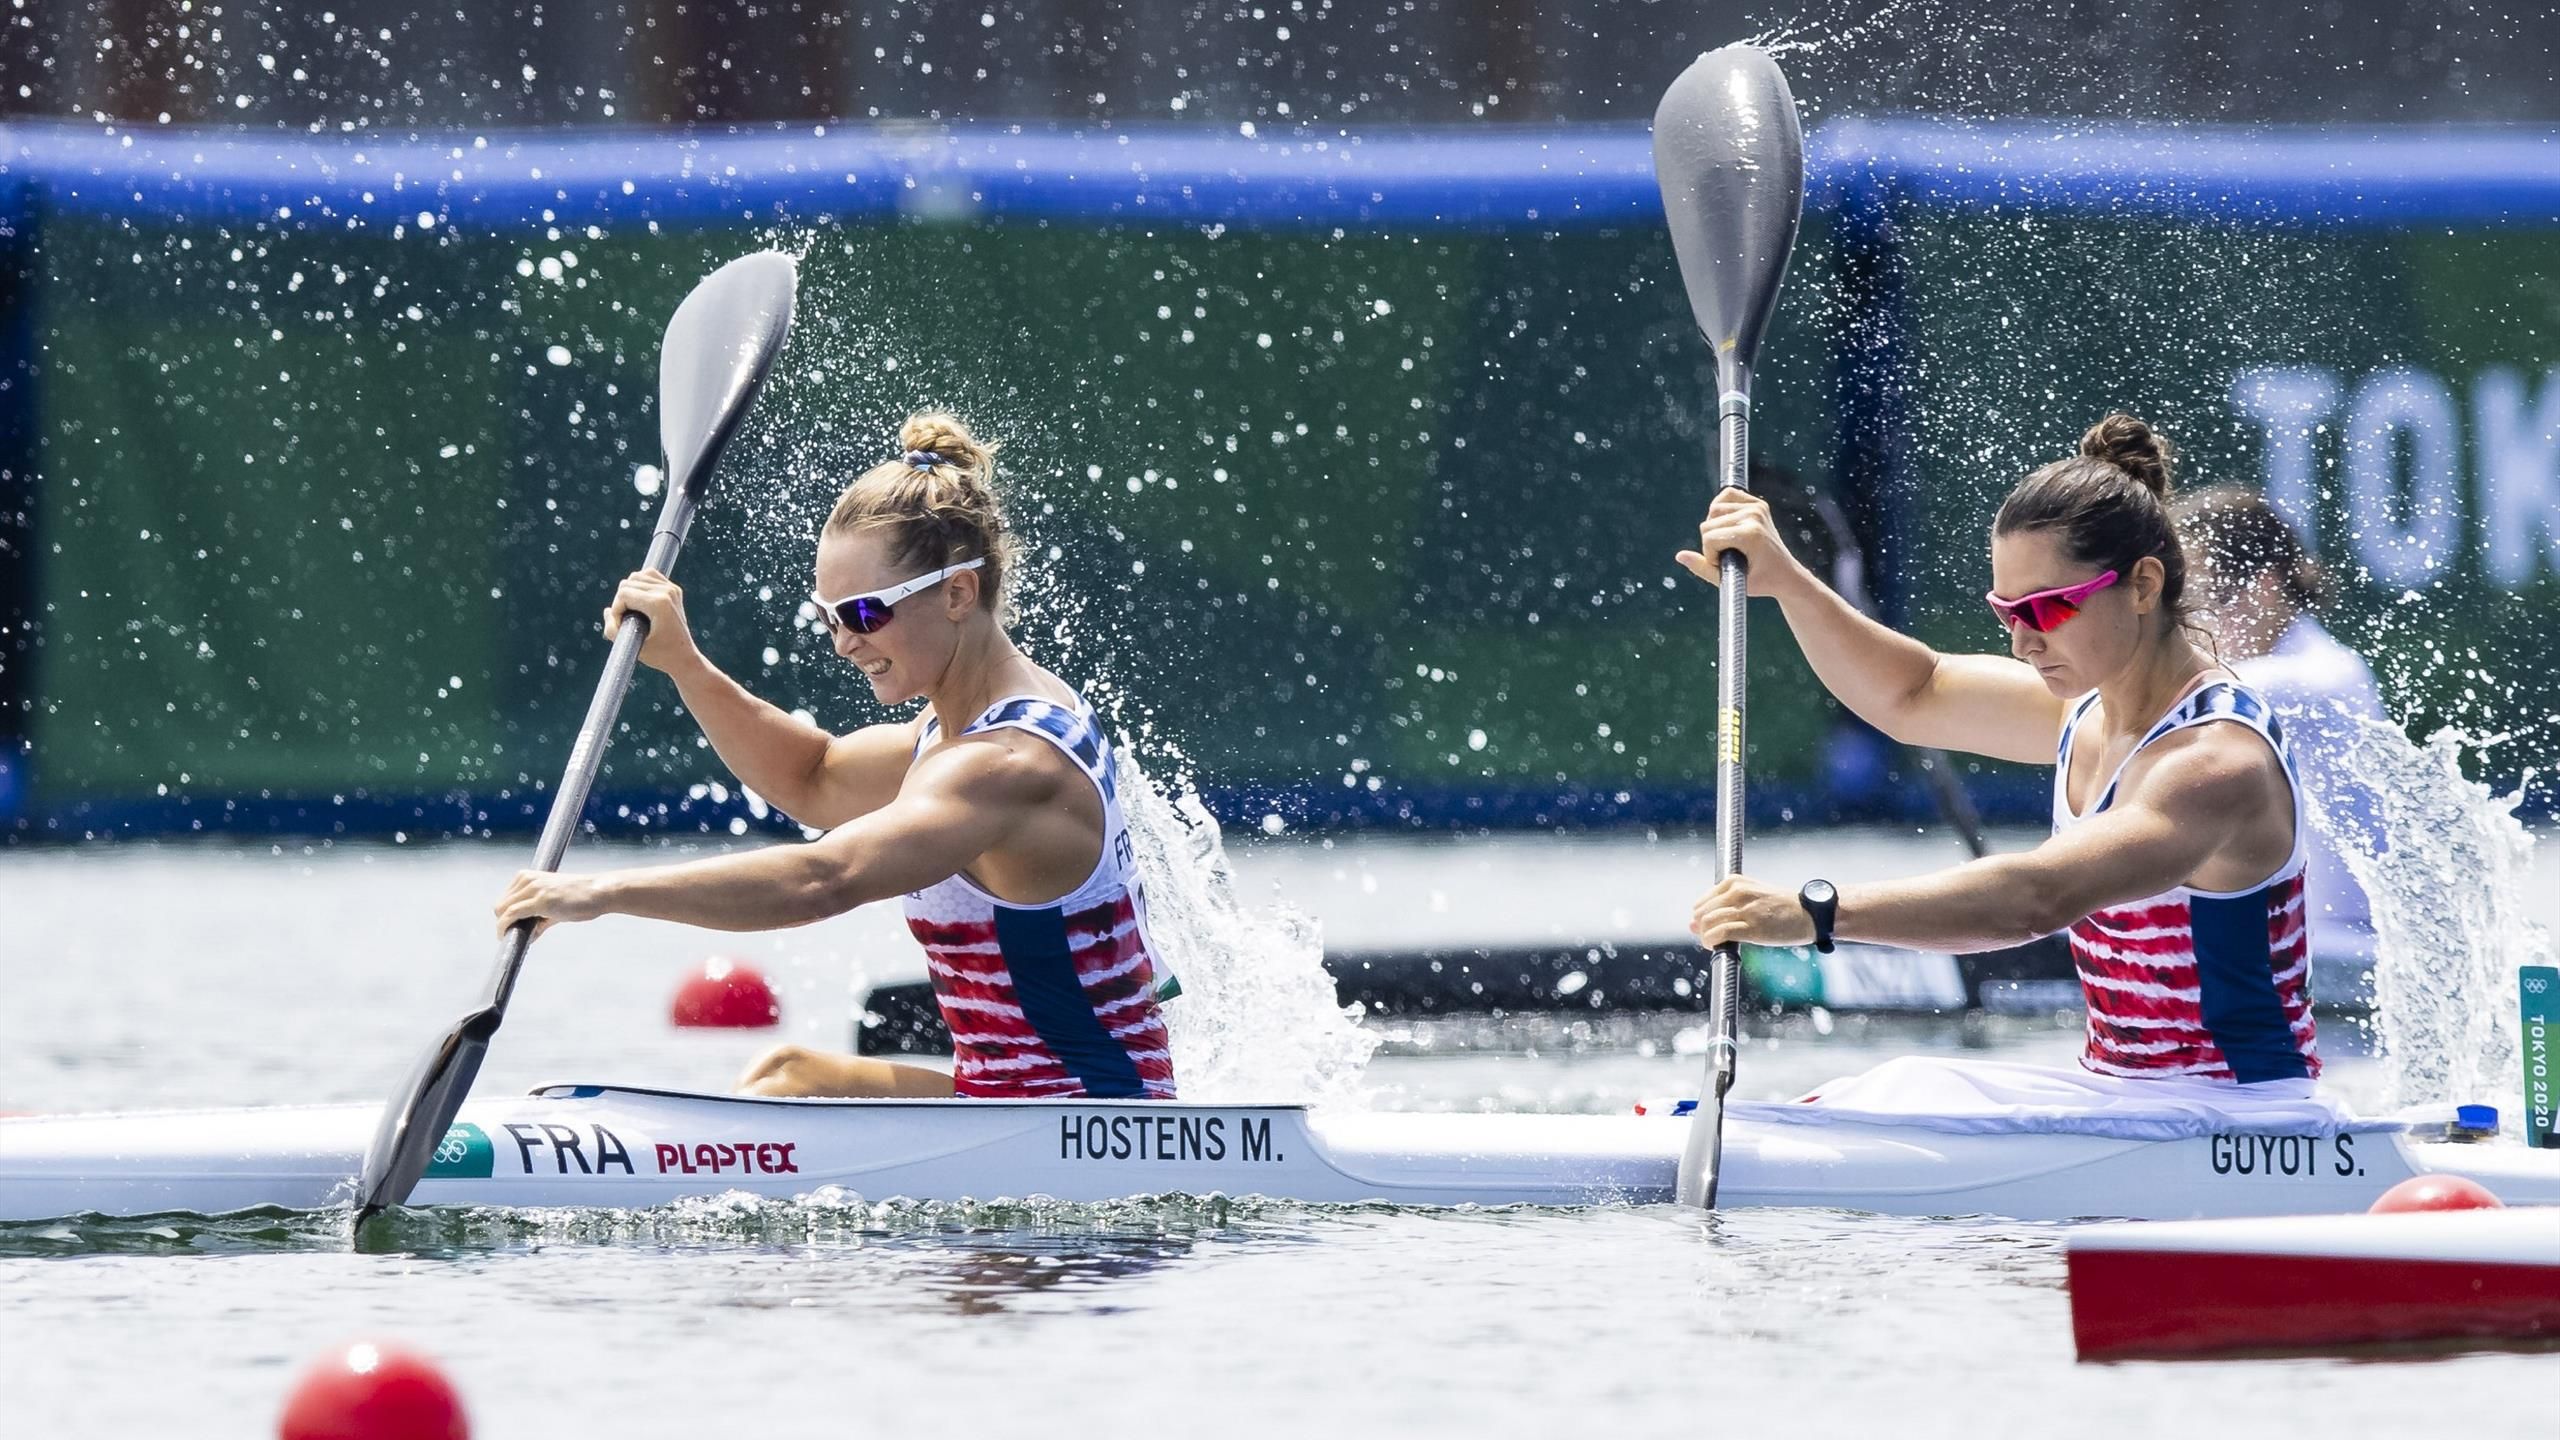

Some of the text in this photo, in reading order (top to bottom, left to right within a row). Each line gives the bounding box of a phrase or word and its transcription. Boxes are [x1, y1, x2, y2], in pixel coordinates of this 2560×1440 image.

[2530, 1014, 2550, 1128] TOKYO 2020
[503, 1124, 635, 1174] FRA
[655, 1142, 799, 1174] PLASTEX
[1060, 1115, 1284, 1162] HOSTENS M.
[2211, 1132, 2365, 1177] GUYOT S.
